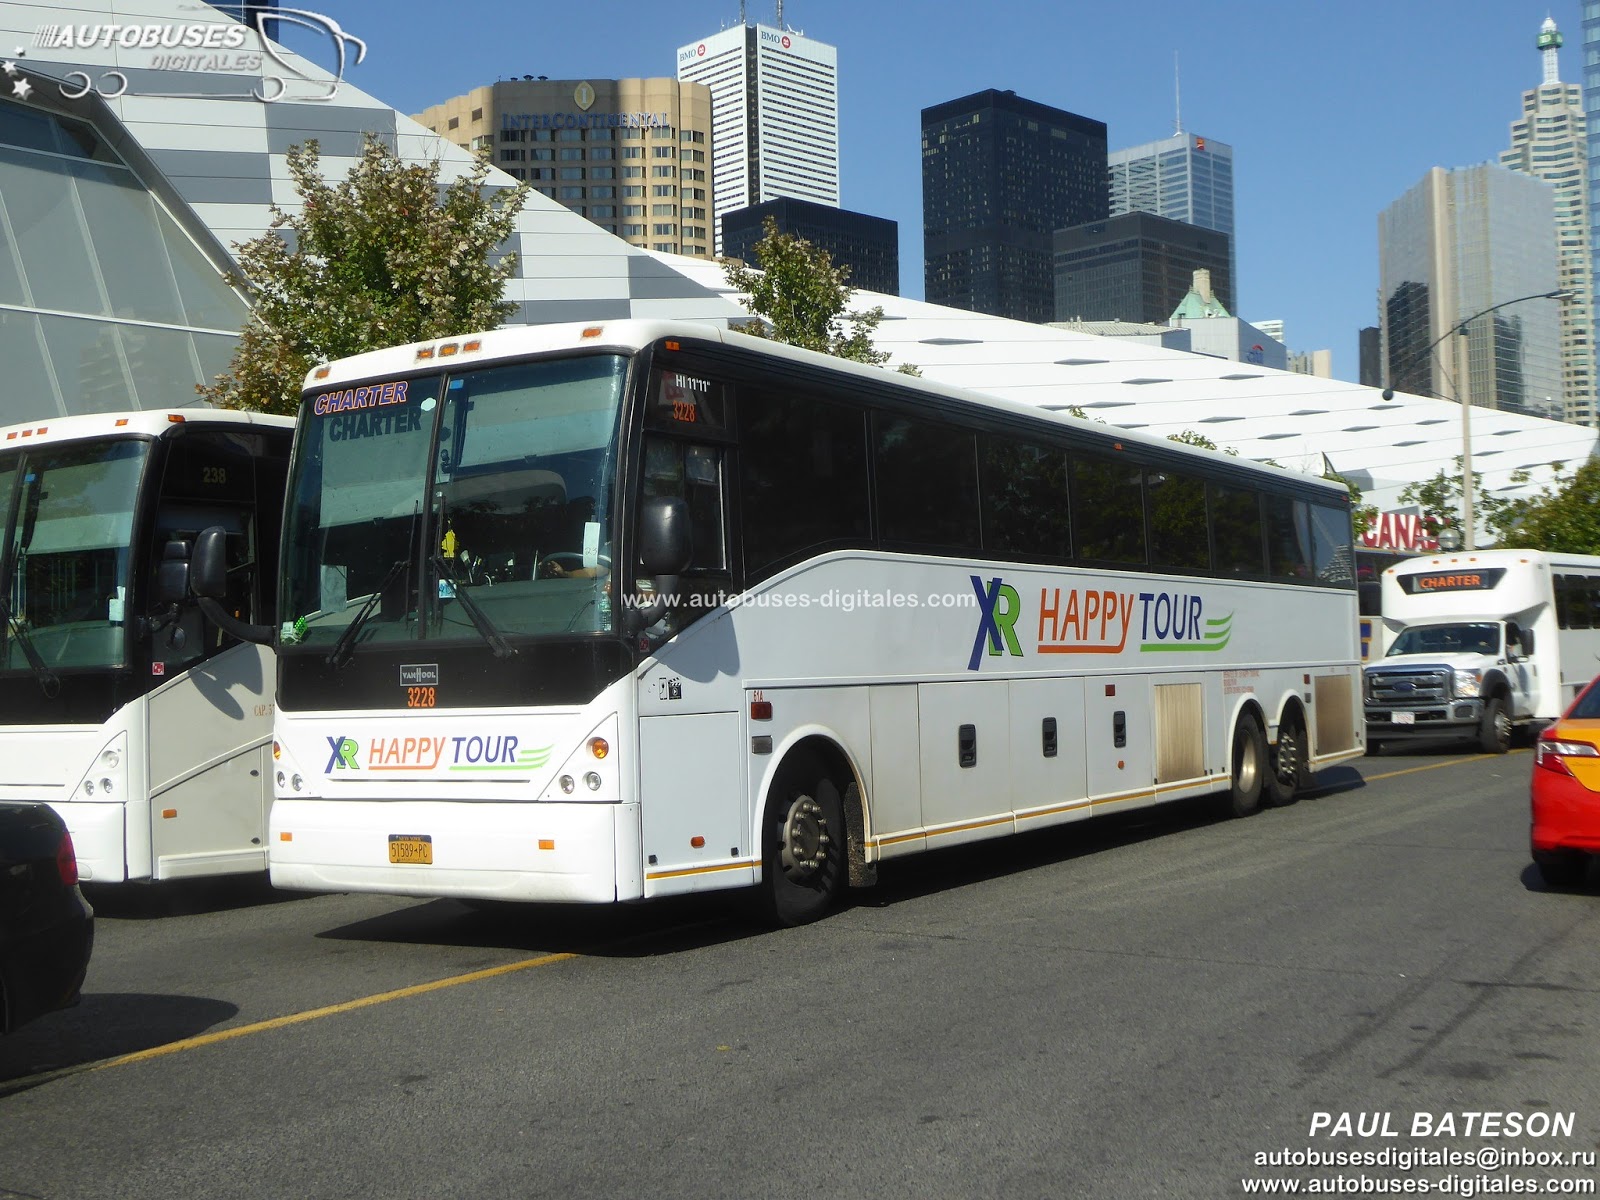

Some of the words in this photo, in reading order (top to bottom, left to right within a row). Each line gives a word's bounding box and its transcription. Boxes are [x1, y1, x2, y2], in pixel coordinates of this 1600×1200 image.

[761, 31, 780, 44] BMO
[680, 49, 696, 61] BMO
[675, 374, 686, 388] HI
[314, 381, 408, 416] CHARTER
[672, 400, 695, 422] 3228
[329, 406, 422, 442] CHARTER
[203, 466, 226, 484] 238
[1420, 574, 1480, 588] CHARTER
[967, 575, 1024, 671] XR
[1037, 588, 1134, 653] HAPPY
[1139, 592, 1202, 640] TOUR
[408, 687, 435, 707] 3228
[324, 736, 359, 773] XR
[368, 737, 446, 770] HAPPY
[452, 736, 518, 763] TOUR
